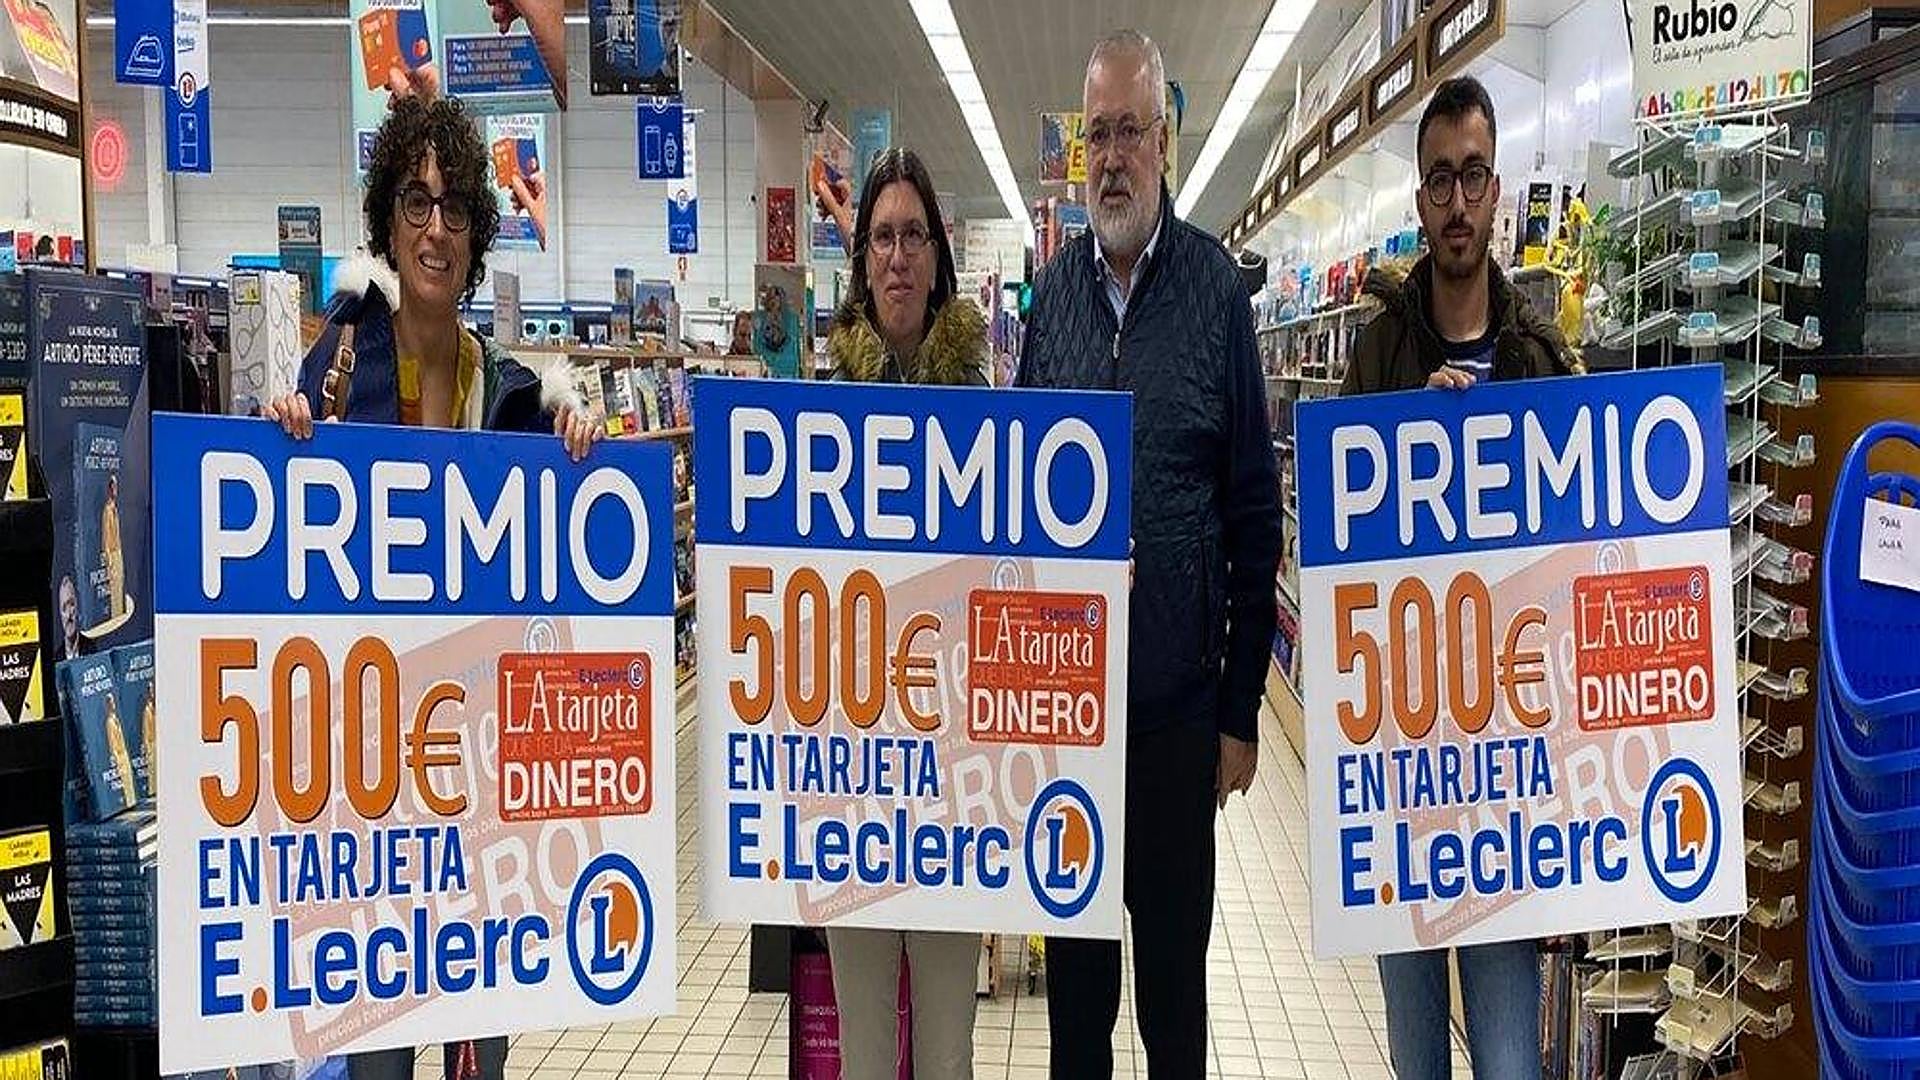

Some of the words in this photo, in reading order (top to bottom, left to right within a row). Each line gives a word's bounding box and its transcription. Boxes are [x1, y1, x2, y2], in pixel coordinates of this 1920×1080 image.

[1653, 0, 1737, 44] Rubio
[44, 343, 81, 364] ARTURO
[729, 406, 1109, 548] PREMIO
[1331, 395, 1704, 552] PREMIO
[202, 451, 650, 605] PREMIO
[3, 651, 20, 666] LAS
[728, 566, 942, 732] 500€
[973, 605, 1015, 664] LA
[1019, 621, 1094, 676] tarjeta
[1334, 570, 1550, 744] 500€
[1578, 590, 1623, 650] LA
[1625, 598, 1698, 655] tarjeta
[504, 670, 553, 734] LA
[556, 682, 638, 743] tarjeta
[973, 688, 1099, 736] DINERO
[1581, 665, 1708, 720] DINERO
[200, 635, 467, 828] 500€
[728, 732, 773, 791] EN
[782, 733, 940, 798] TARJETA
[504, 756, 646, 811] DINERO
[1337, 752, 1386, 815] EN
[1392, 736, 1555, 810] TARJETA
[14, 872, 32, 887] LAS
[200, 837, 260, 910] EN
[270, 826, 467, 903] TARJETA
[728, 802, 1011, 889] E.Leclerc
[1339, 811, 1628, 907] E.Leclerc
[6, 885, 41, 903] MADRES
[200, 908, 550, 1017] E.Leclerc
